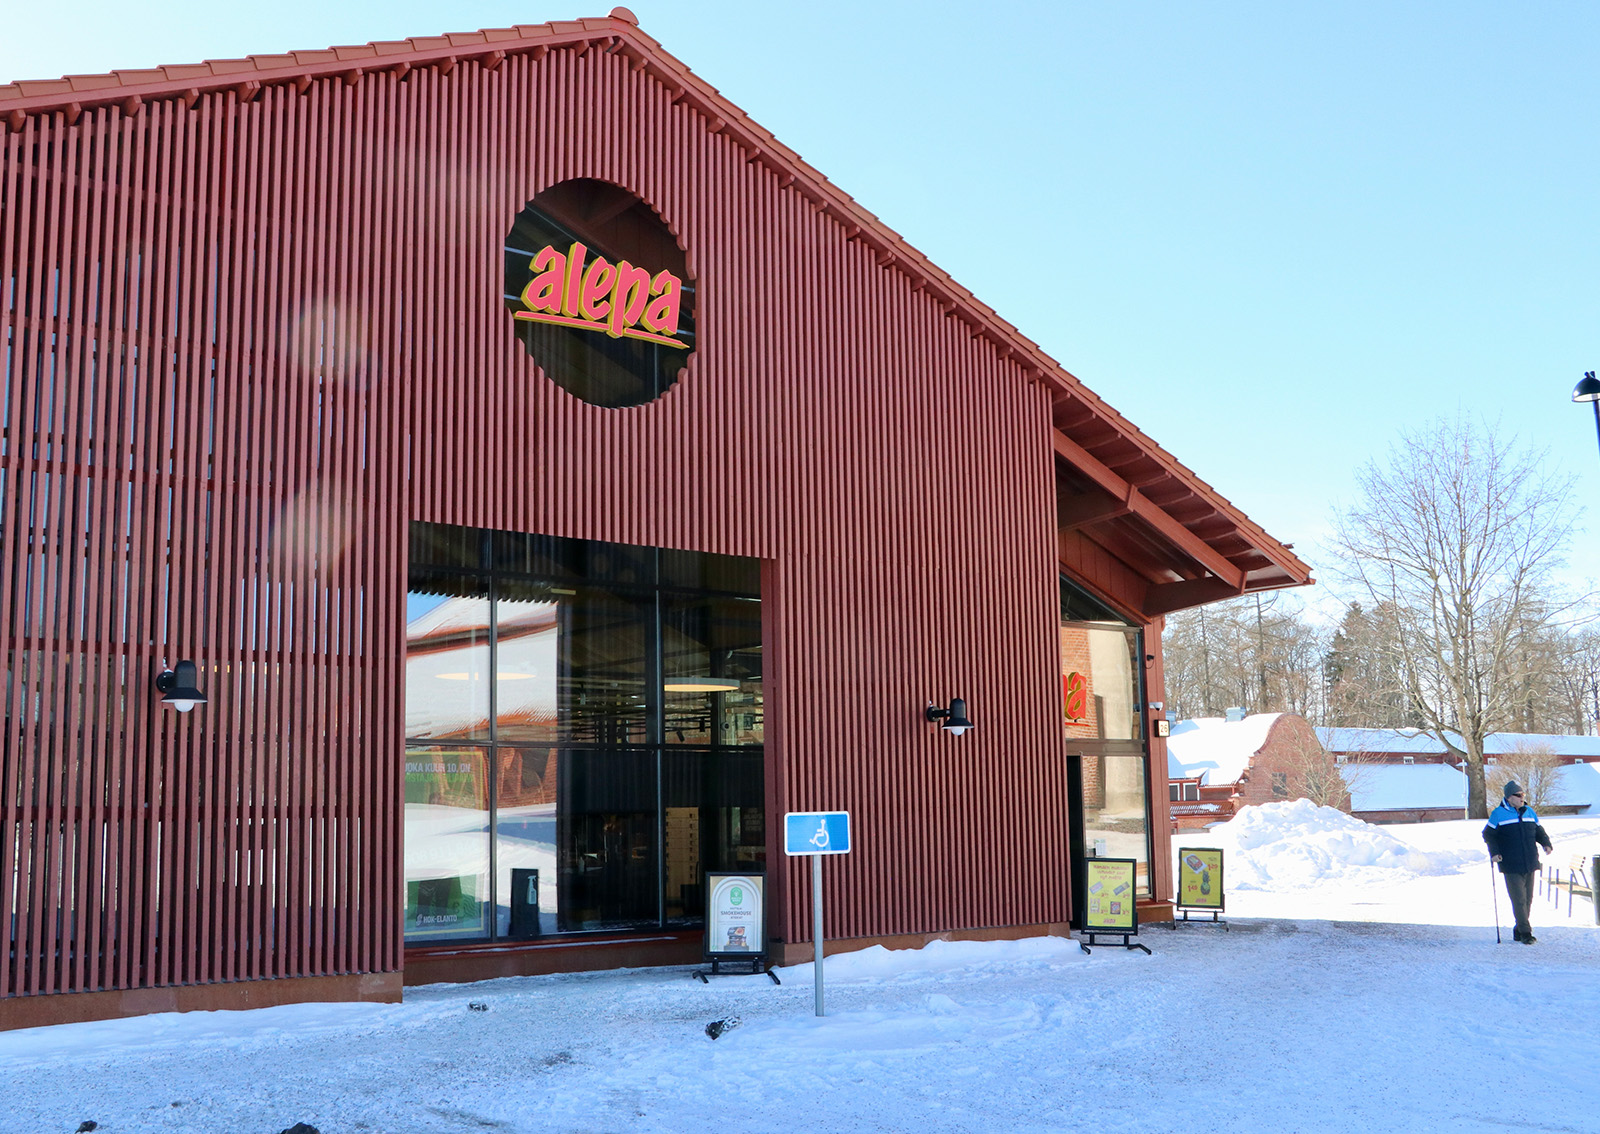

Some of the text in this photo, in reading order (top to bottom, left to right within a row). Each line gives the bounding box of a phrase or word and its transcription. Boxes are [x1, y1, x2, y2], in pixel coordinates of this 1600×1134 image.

[521, 241, 682, 339] alepa
[1160, 724, 1168, 733] 26
[423, 914, 458, 924] HOK-ELANTO
